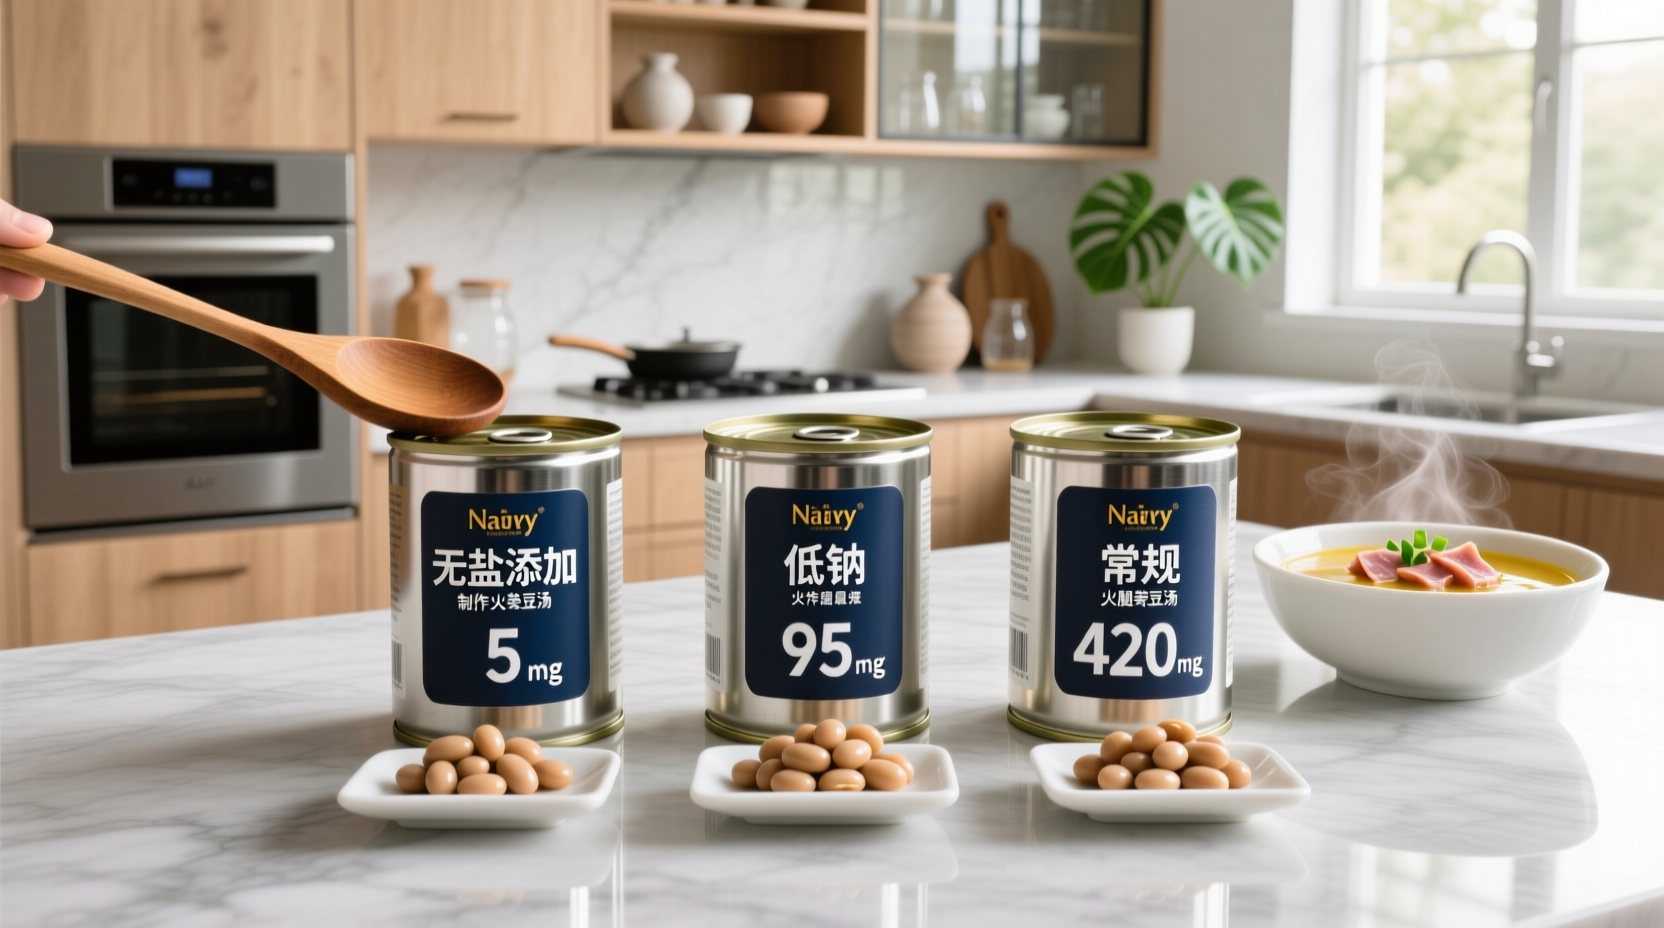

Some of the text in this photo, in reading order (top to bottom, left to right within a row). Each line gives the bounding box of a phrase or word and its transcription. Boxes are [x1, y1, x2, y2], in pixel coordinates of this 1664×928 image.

[432, 546, 577, 587] 无盐添加
[784, 543, 866, 586] 低钠
[1101, 544, 1181, 585] 常规
[485, 627, 563, 686] 5 mg
